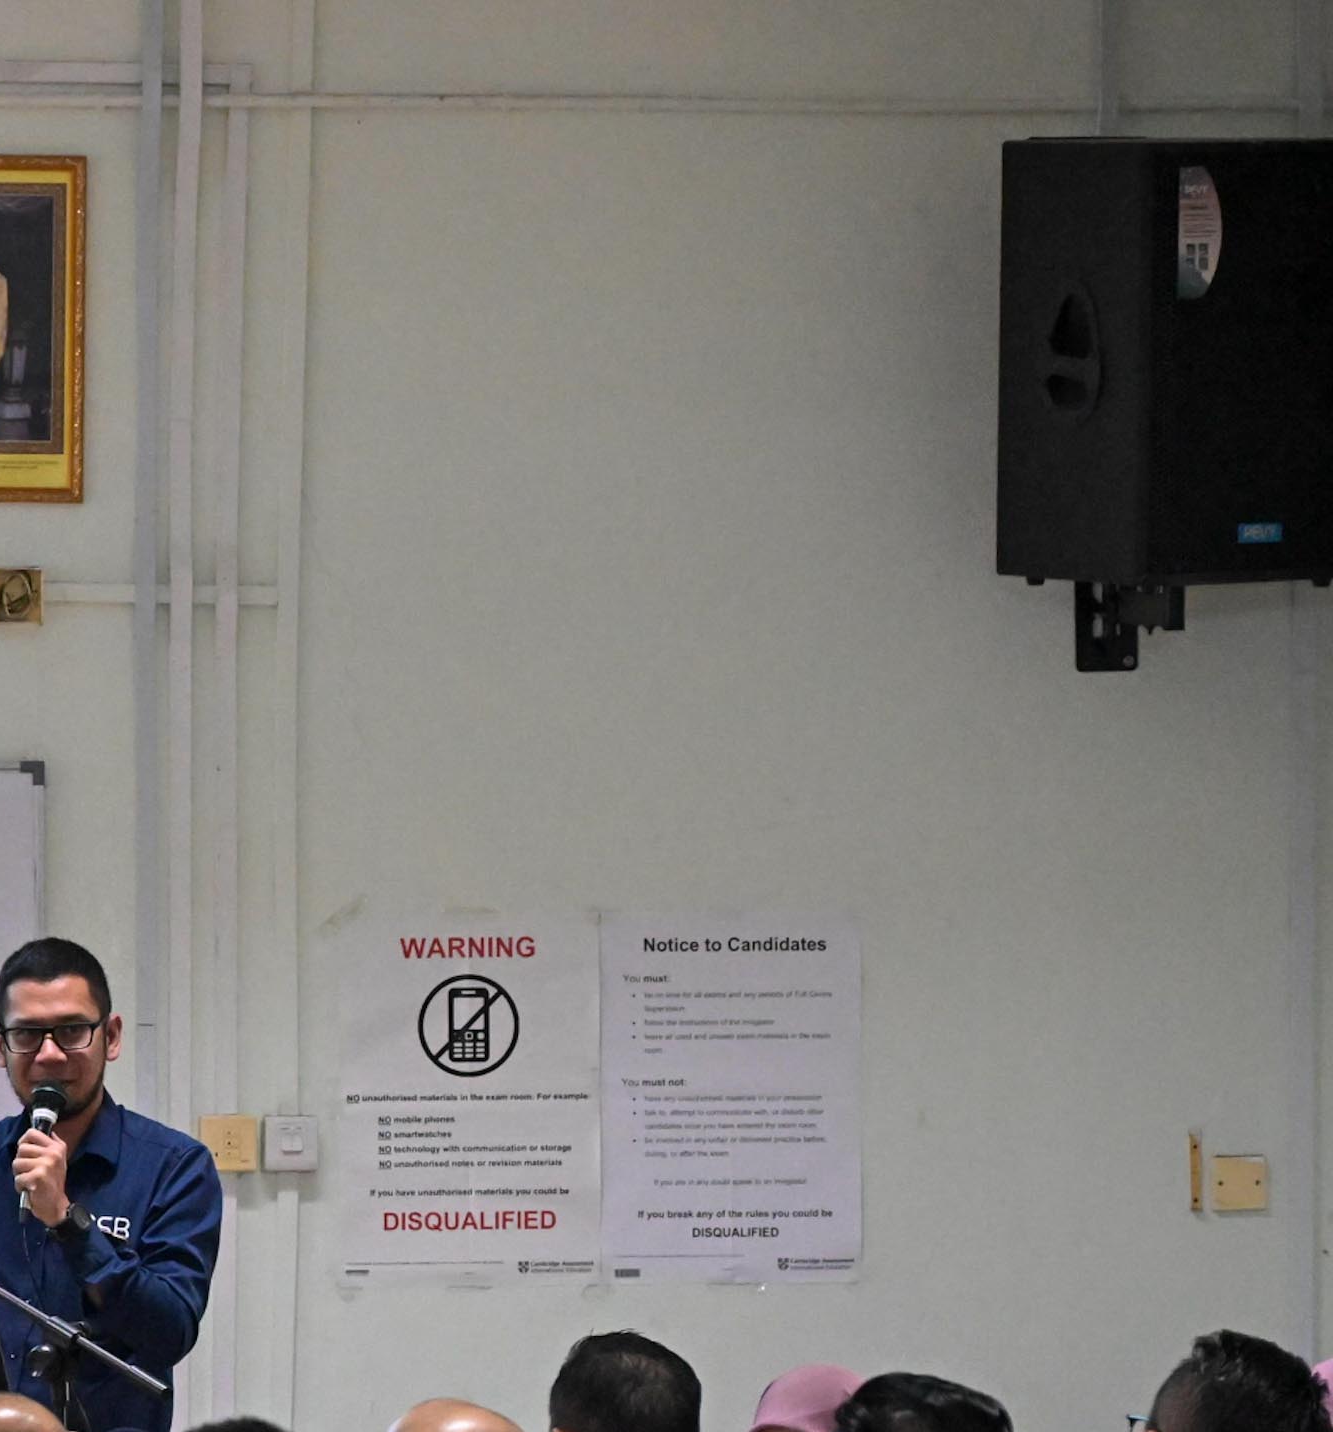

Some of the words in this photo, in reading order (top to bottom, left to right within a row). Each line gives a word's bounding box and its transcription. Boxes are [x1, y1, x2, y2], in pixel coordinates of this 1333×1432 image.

[400, 936, 535, 959] WARNING
[643, 937, 699, 952] Notice
[704, 938, 722, 952] to
[728, 937, 826, 952] Candidates
[641, 1078, 666, 1087] must
[346, 1094, 360, 1104] NO
[361, 1093, 418, 1104] unauthorised
[419, 1093, 459, 1104] materials
[536, 1091, 552, 1102] For
[378, 1115, 392, 1126] NO
[393, 1115, 422, 1124] mobile
[424, 1115, 456, 1125] phones
[378, 1130, 392, 1141] NO
[378, 1144, 392, 1155] NO
[393, 1145, 440, 1155] technology
[442, 1145, 461, 1154] with
[462, 1144, 527, 1153] communication
[378, 1159, 393, 1170] NO
[393, 1159, 450, 1169] unauthorised
[451, 1159, 475, 1167] notes
[488, 1158, 523, 1167] revision
[524, 1157, 563, 1167] materials
[377, 1190, 394, 1199] you
[395, 1189, 416, 1197] have
[417, 1188, 473, 1197] unauthorised
[475, 1187, 513, 1196] materials
[515, 1187, 532, 1197] you
[533, 1187, 558, 1195] could
[559, 1186, 570, 1195] be
[384, 1210, 556, 1232] DISQUALIFIED
[647, 1212, 665, 1221] you
[696, 1210, 713, 1220] any
[716, 1210, 726, 1218] of
[745, 1210, 770, 1218] rules
[772, 1210, 790, 1219] you
[792, 1209, 819, 1218] could
[821, 1209, 833, 1217] be
[90, 1213, 131, 1240] SB
[692, 1227, 779, 1238] DISQUALIFIED
